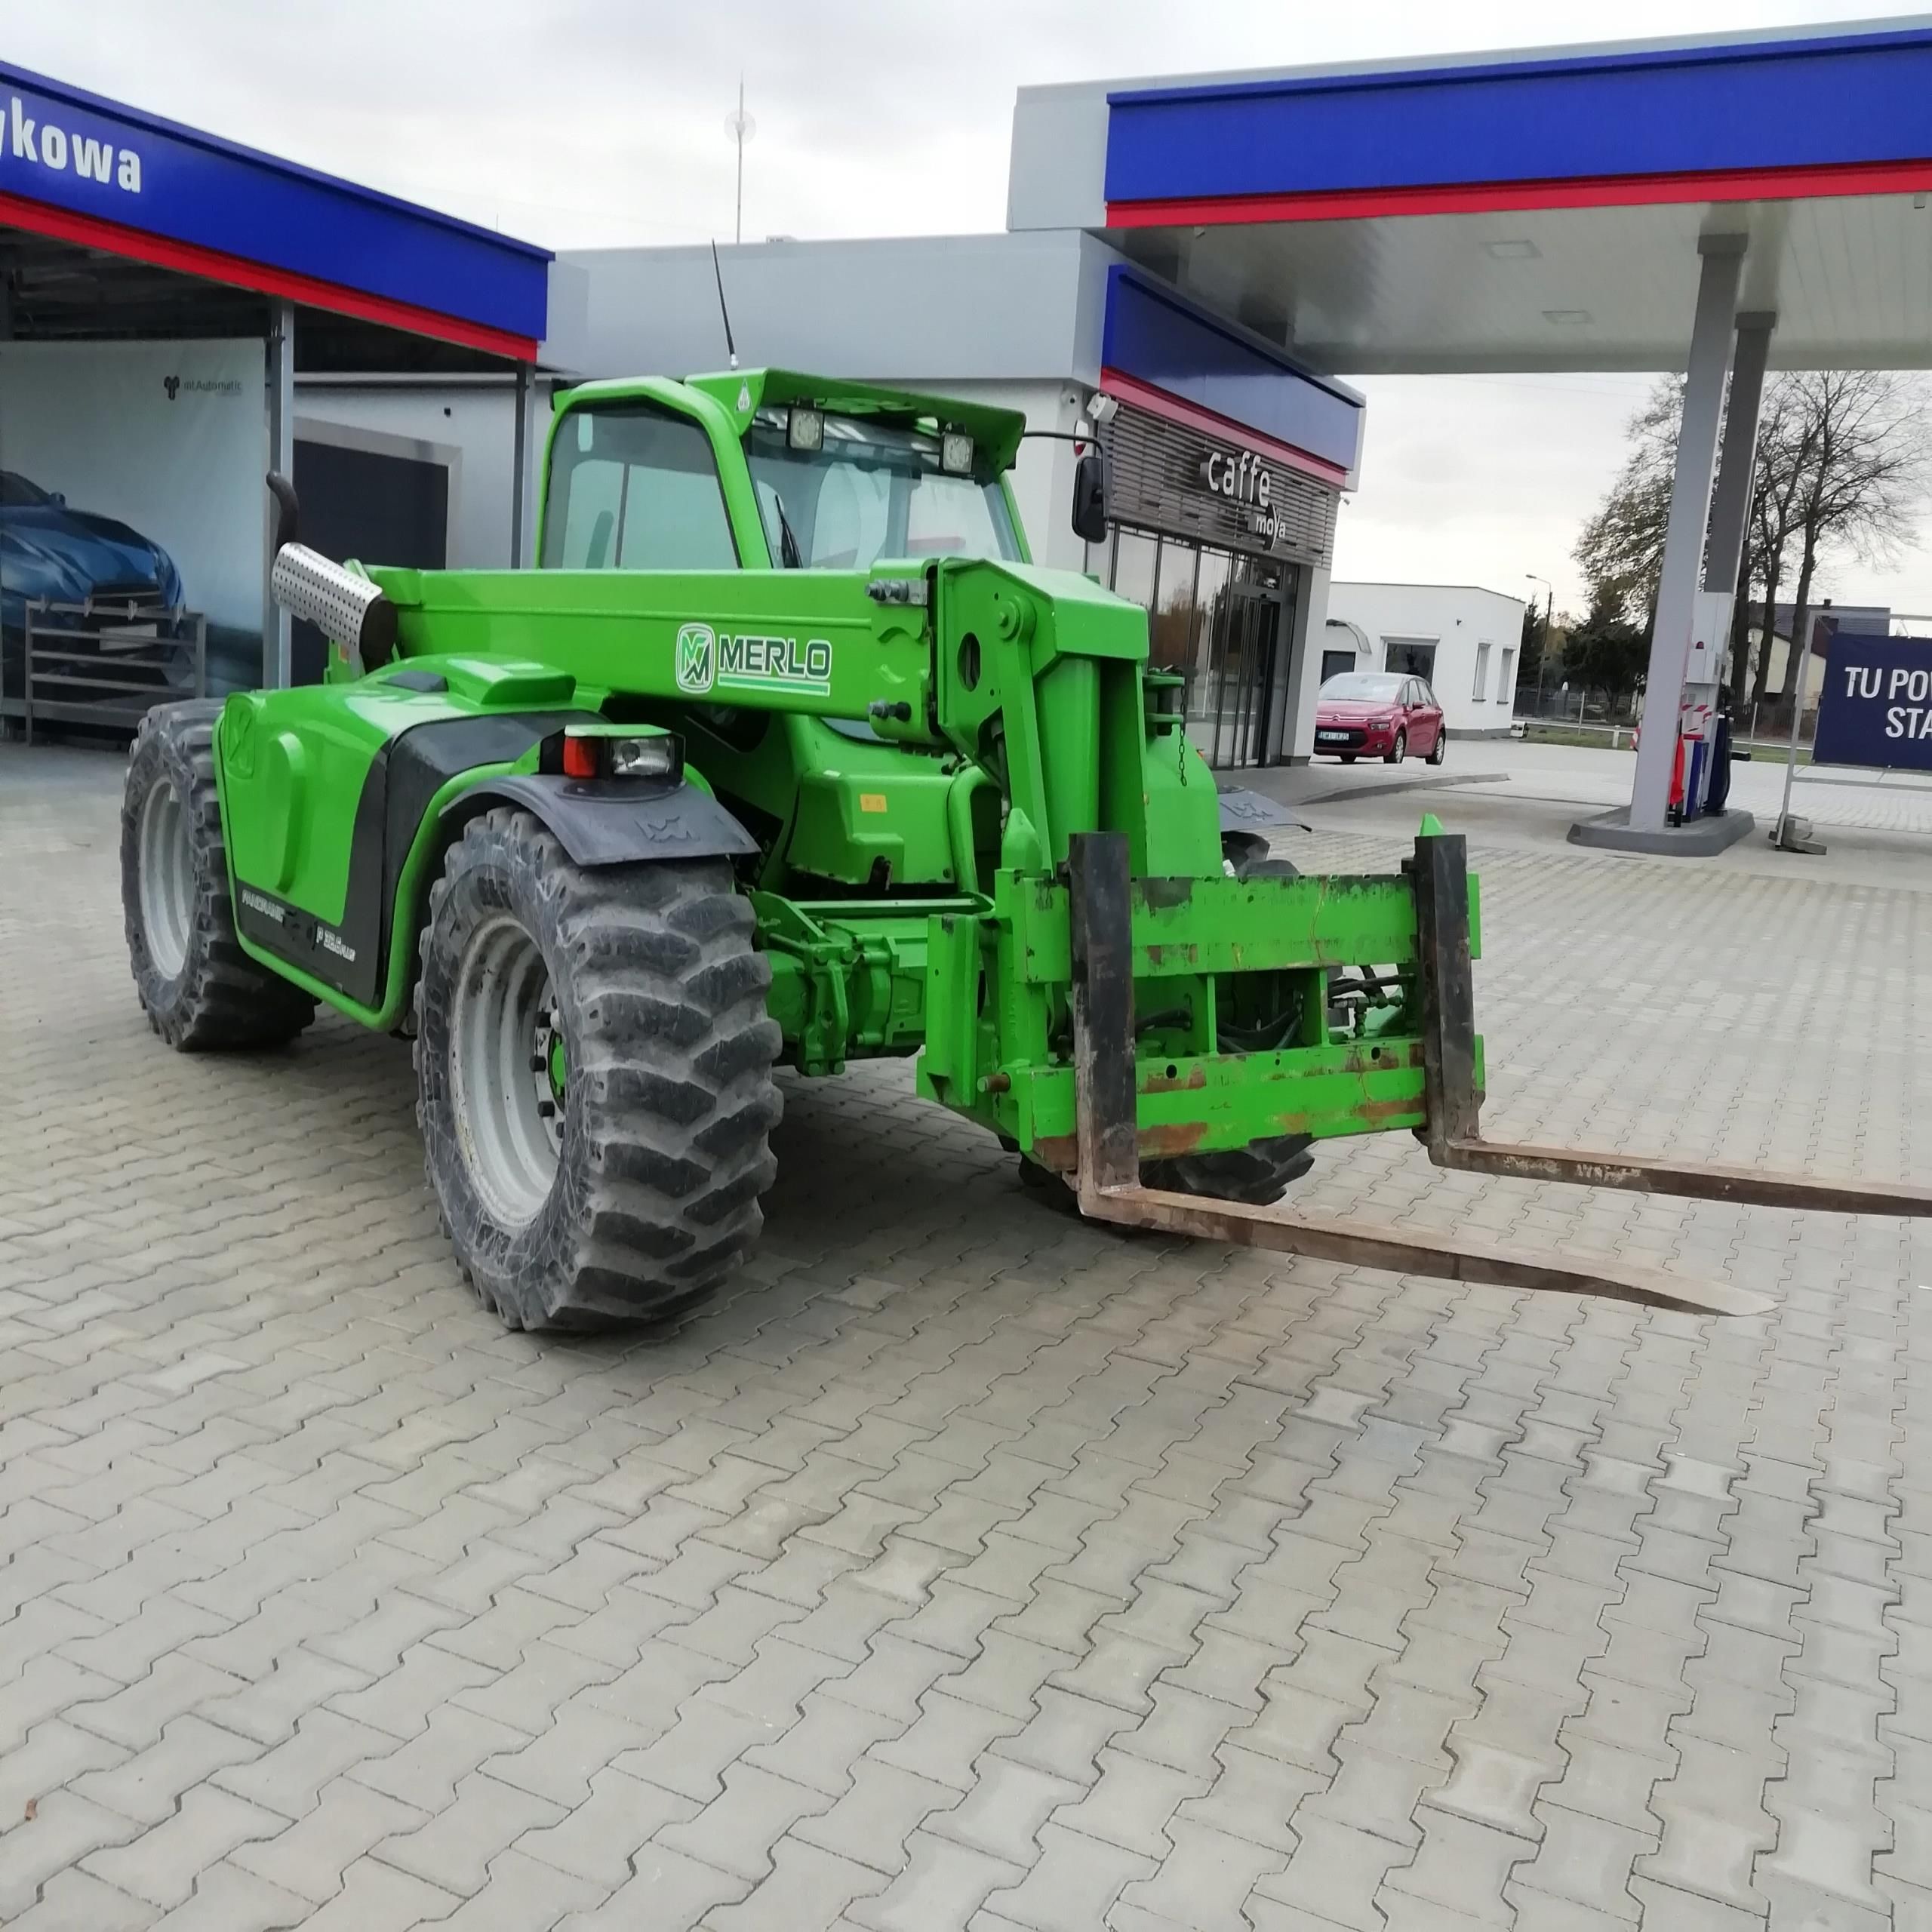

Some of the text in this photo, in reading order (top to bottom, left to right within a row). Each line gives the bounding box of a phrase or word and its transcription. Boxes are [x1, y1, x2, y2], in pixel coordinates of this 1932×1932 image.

[0, 97, 141, 193] kowa
[1208, 451, 1269, 507] caffe
[718, 635, 832, 679] MERLO
[1844, 666, 1932, 701] TU PO
